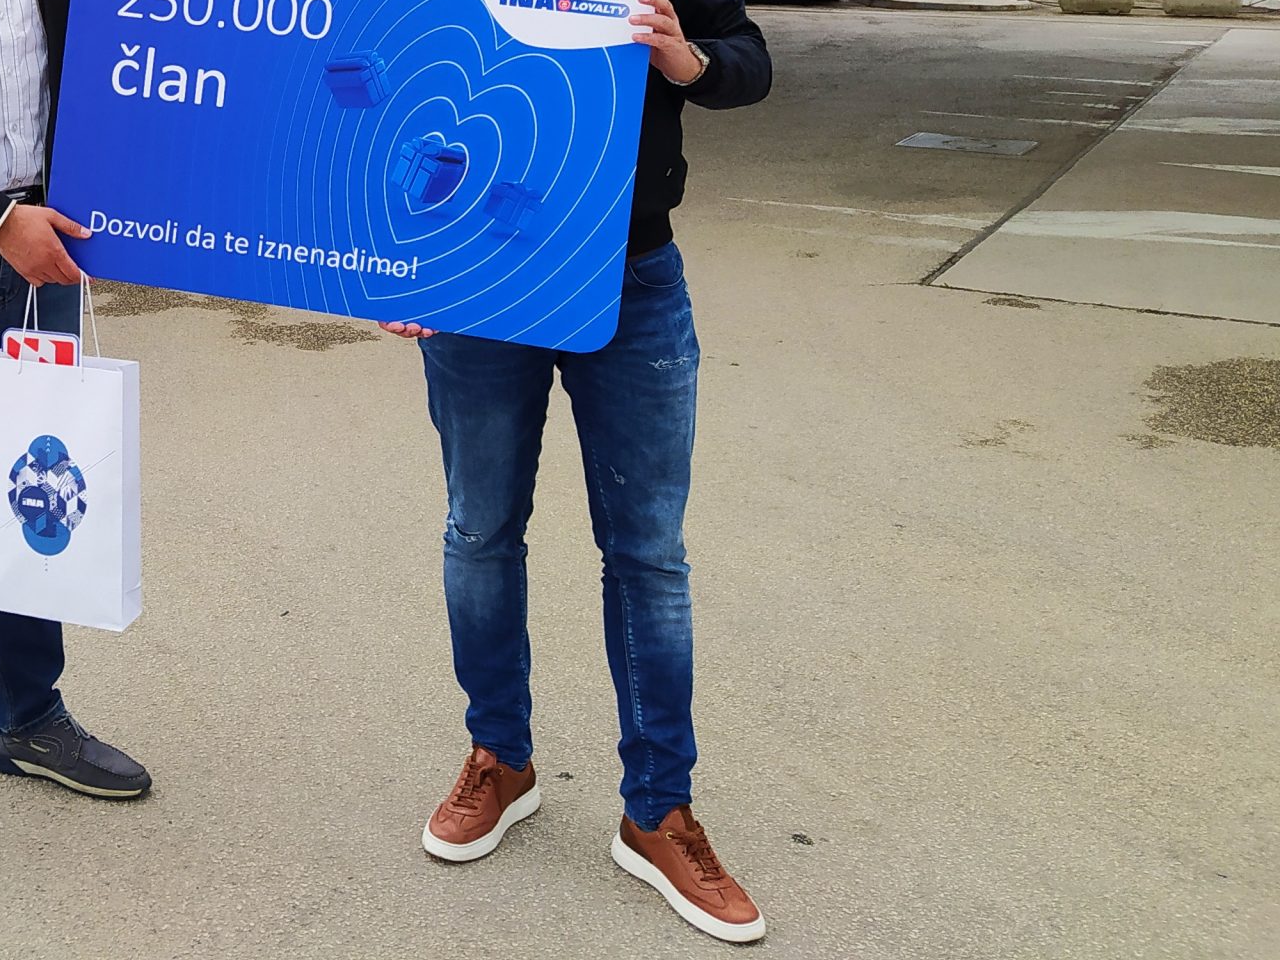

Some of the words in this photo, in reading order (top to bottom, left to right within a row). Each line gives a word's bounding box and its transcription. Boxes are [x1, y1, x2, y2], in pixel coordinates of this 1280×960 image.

[571, 1, 627, 16] LOYALTY
[111, 43, 226, 108] član
[90, 211, 178, 244] Dozvoli
[186, 224, 215, 250] da
[224, 231, 249, 254] te
[257, 235, 418, 279] iznenadimo!
